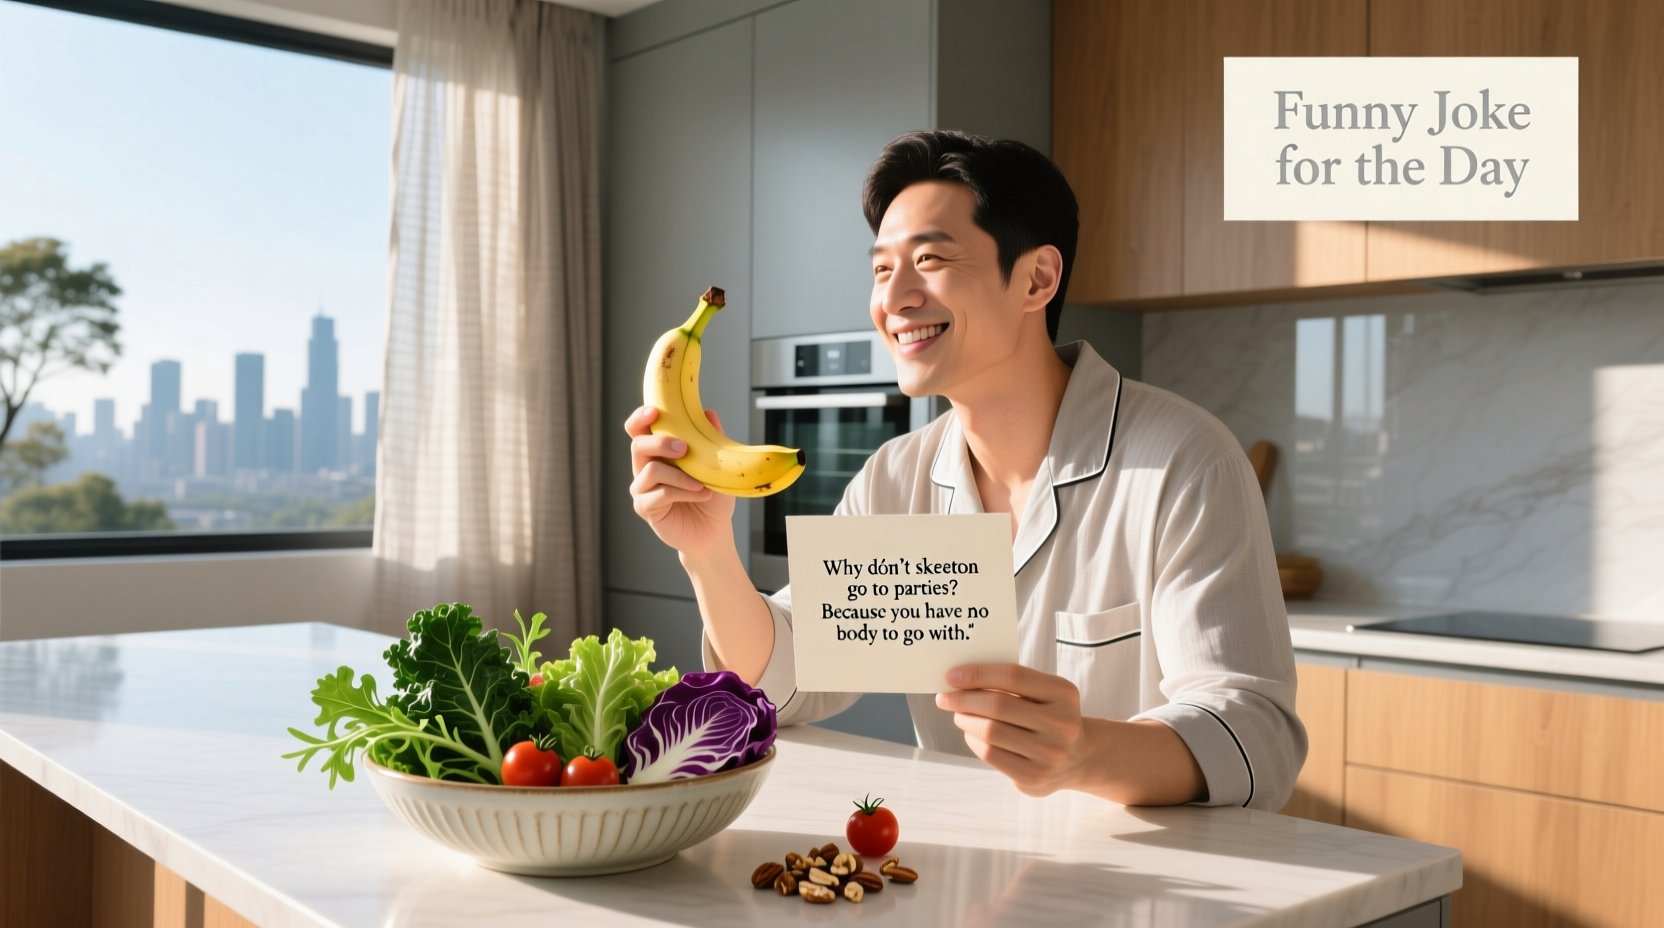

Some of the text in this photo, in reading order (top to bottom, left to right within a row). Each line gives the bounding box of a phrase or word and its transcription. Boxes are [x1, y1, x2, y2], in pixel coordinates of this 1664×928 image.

[823, 558, 864, 580] Why
[915, 556, 980, 575] skeeton
[847, 578, 959, 602] go to parties?
[890, 606, 921, 623] you
[924, 602, 963, 619] have
[967, 606, 990, 619] no
[836, 622, 878, 646] body
[882, 628, 899, 641] to
[902, 629, 925, 647] go
